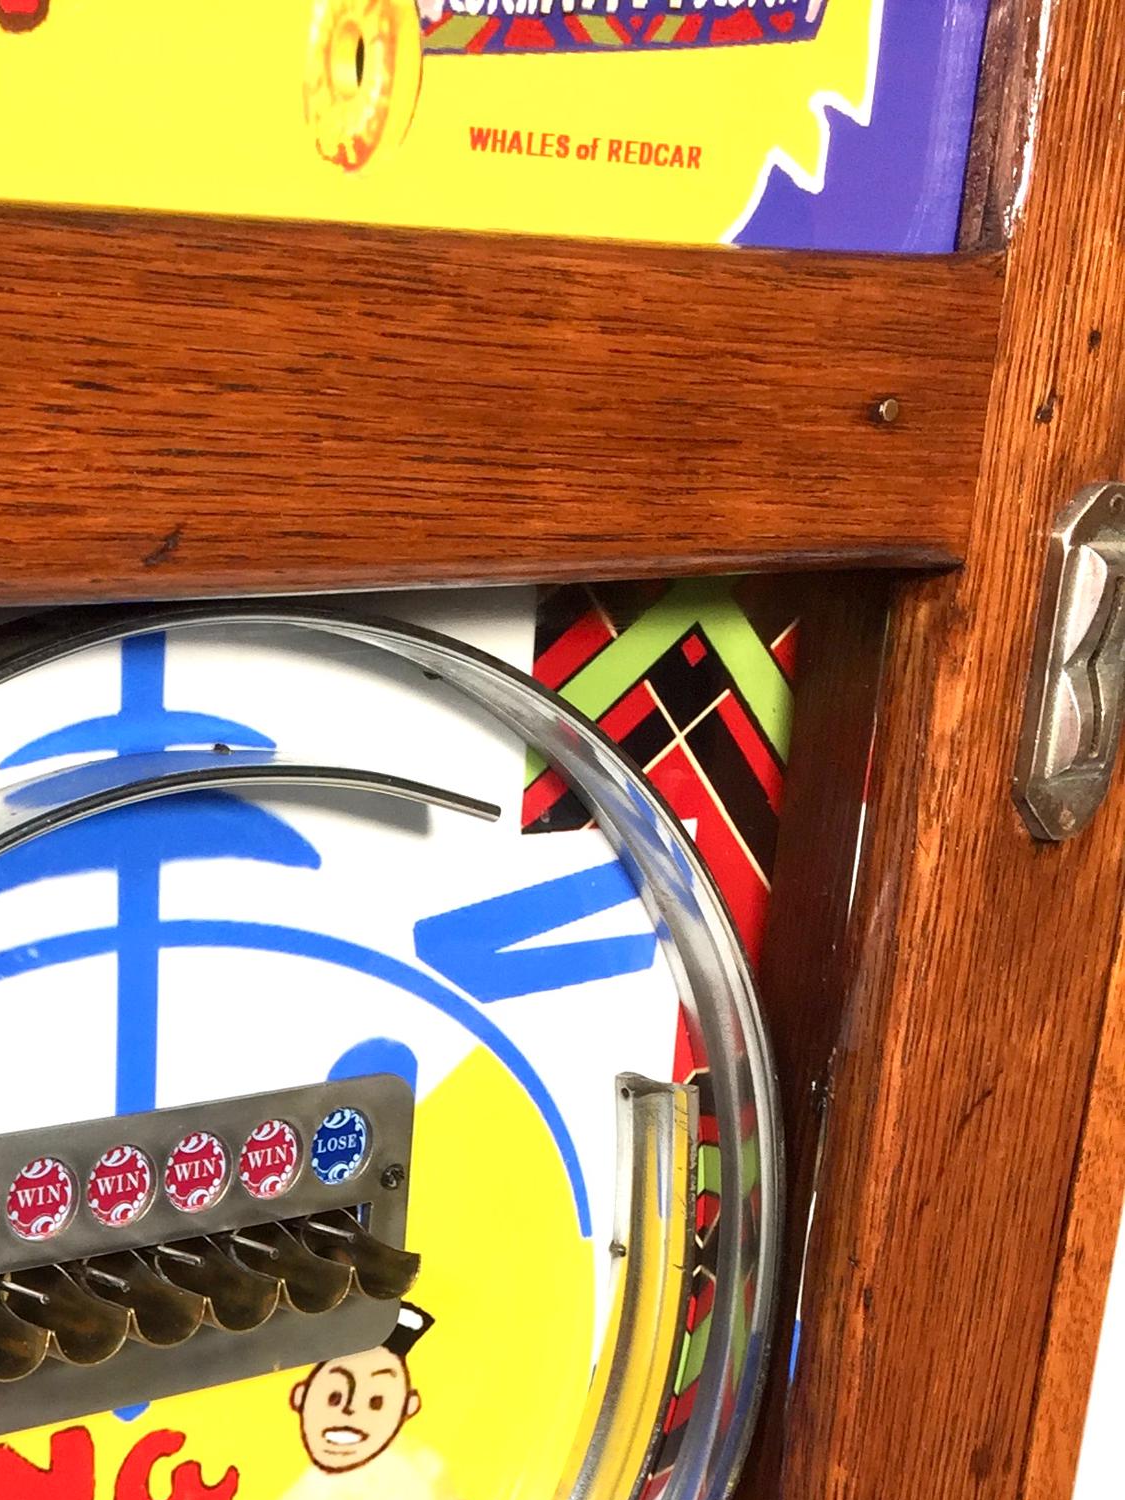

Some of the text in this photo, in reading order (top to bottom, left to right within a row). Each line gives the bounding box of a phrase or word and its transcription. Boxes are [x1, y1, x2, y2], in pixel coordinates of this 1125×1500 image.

[470, 126, 702, 169] WHALES of REDCAR
[317, 1133, 357, 1153] LOSE
[175, 1157, 217, 1181] WIN
[247, 1144, 288, 1169] WIN
[16, 1183, 62, 1208] WIN
[96, 1171, 141, 1196] WIN
